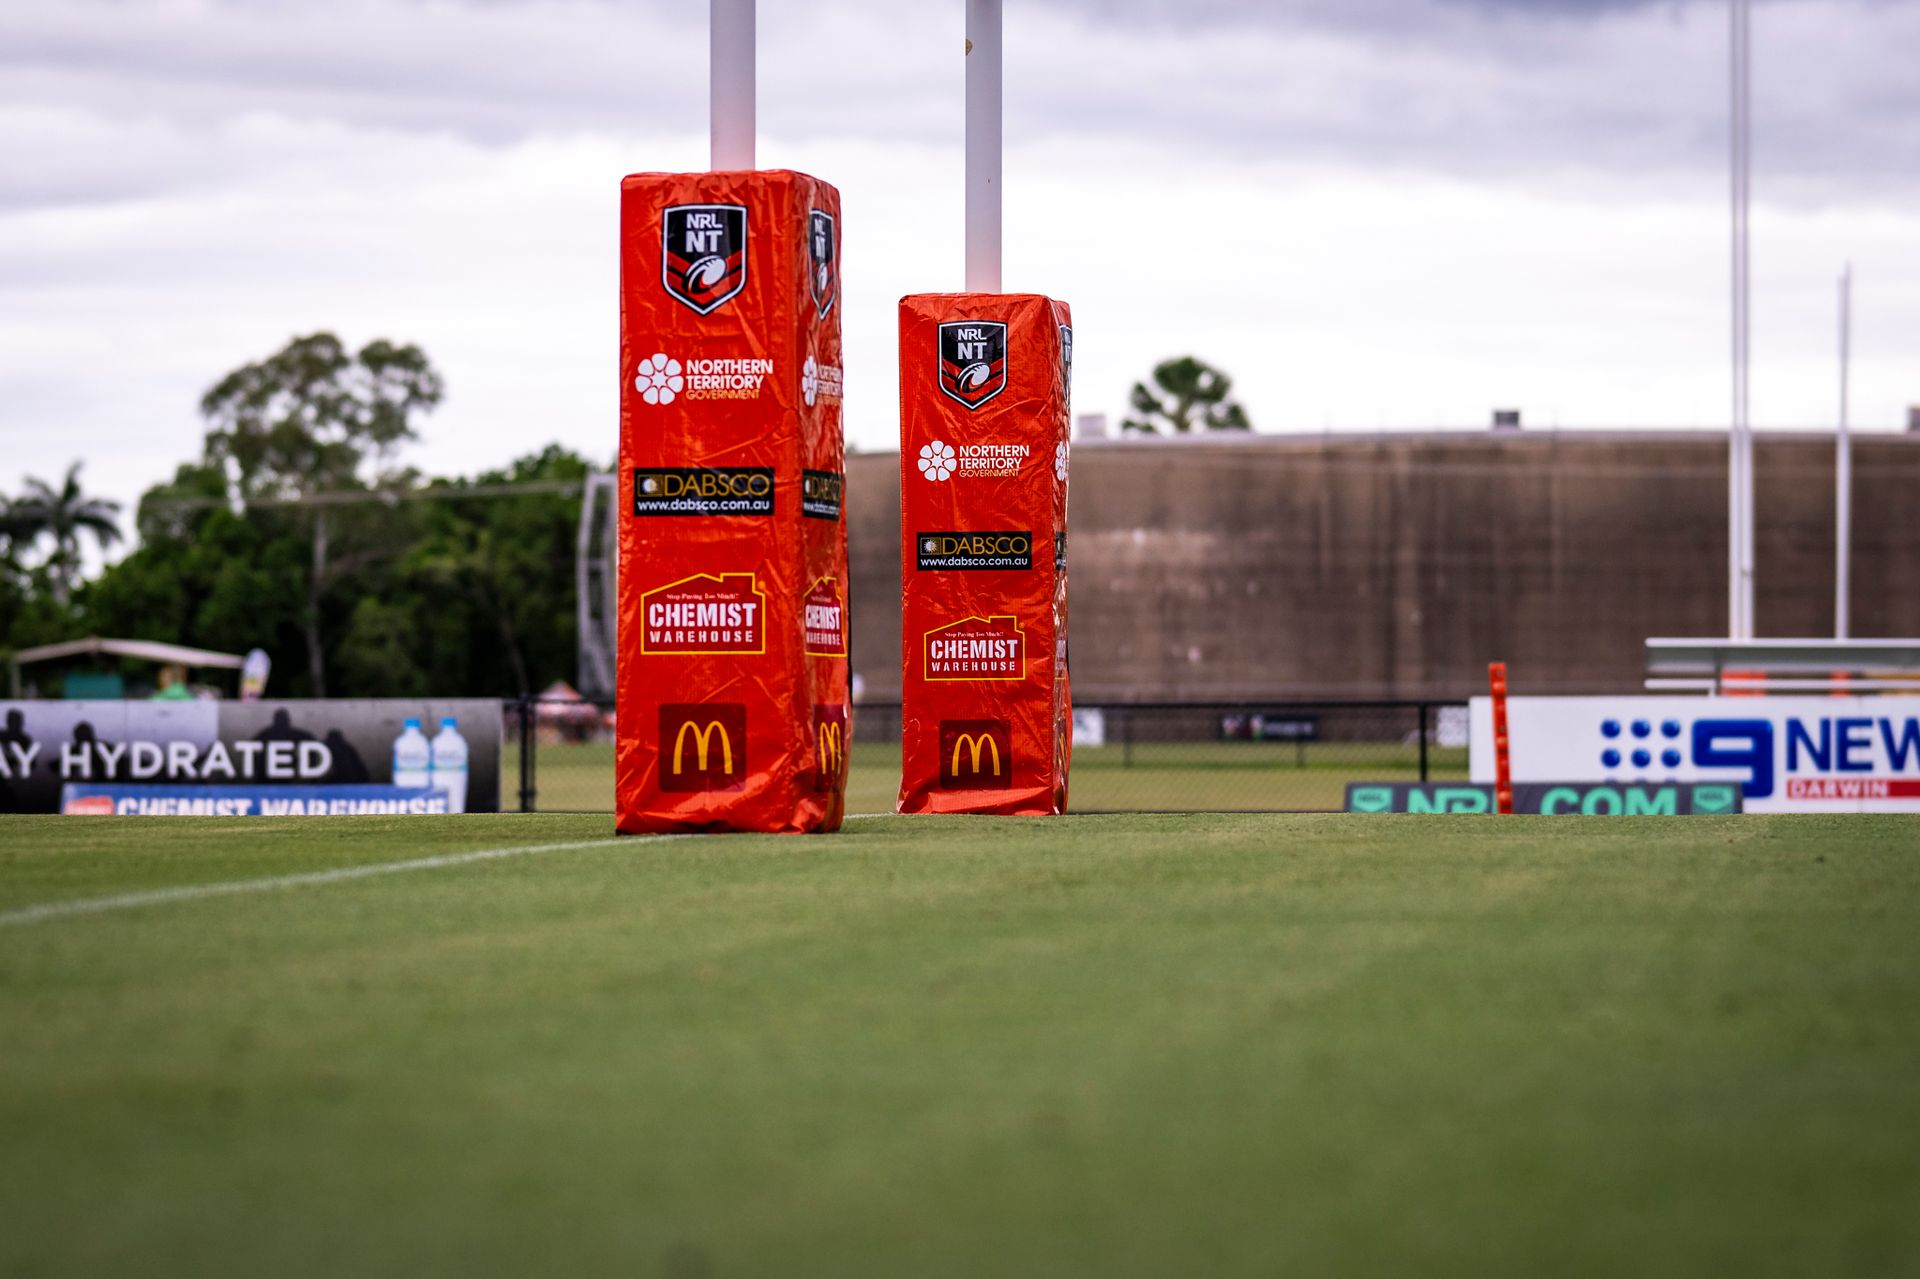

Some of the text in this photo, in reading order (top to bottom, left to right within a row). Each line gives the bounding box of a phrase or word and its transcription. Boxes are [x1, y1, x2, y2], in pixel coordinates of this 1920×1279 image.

[686, 213, 723, 229] NRL
[686, 231, 723, 253] NT
[957, 328, 987, 341] NRL
[957, 342, 987, 360] NT
[686, 359, 774, 375] NORTHERN
[686, 375, 764, 390] TERRITORY
[686, 389, 760, 400] GOVERNMENT
[959, 444, 1030, 457] NORTHERN
[959, 457, 1023, 469] TERRITORY
[958, 469, 1019, 478] GOVERNMENT
[664, 473, 770, 497] DABSCO
[637, 498, 770, 511] www.dabsco.com.au
[942, 536, 1028, 555] DABSCO
[920, 556, 1028, 567] www.dabsco.com.au
[649, 602, 757, 628] CHEMIST
[649, 630, 753, 643] WAREHOUSE
[930, 639, 1018, 660] CHEMIST
[931, 661, 1016, 672] WAREHOUSE
[60, 740, 333, 779] HYDRATED
[1790, 779, 1889, 798] DARWIN
